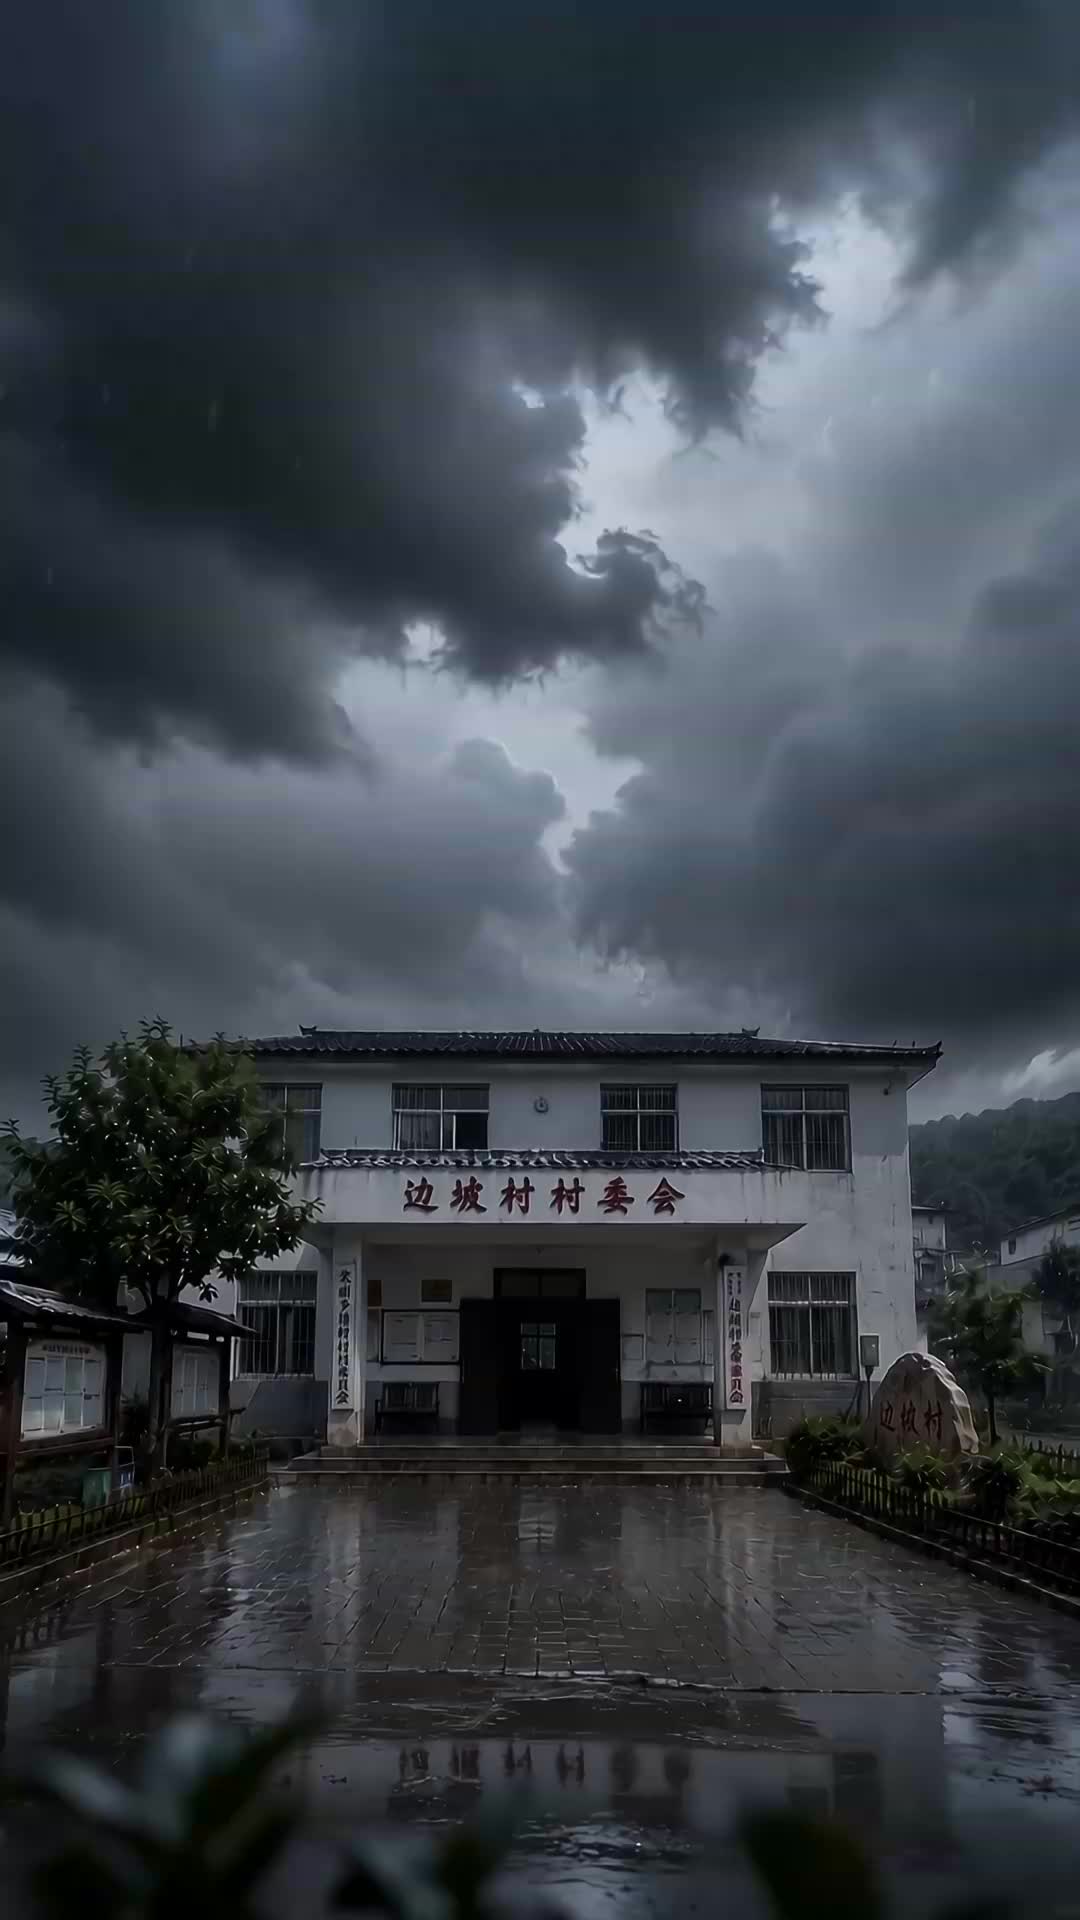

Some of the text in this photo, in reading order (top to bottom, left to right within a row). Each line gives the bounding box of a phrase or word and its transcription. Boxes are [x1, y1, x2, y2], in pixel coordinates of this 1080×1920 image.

[402, 1175, 686, 1216] 边坡村村委会
[880, 1399, 944, 1440] 边坡村
